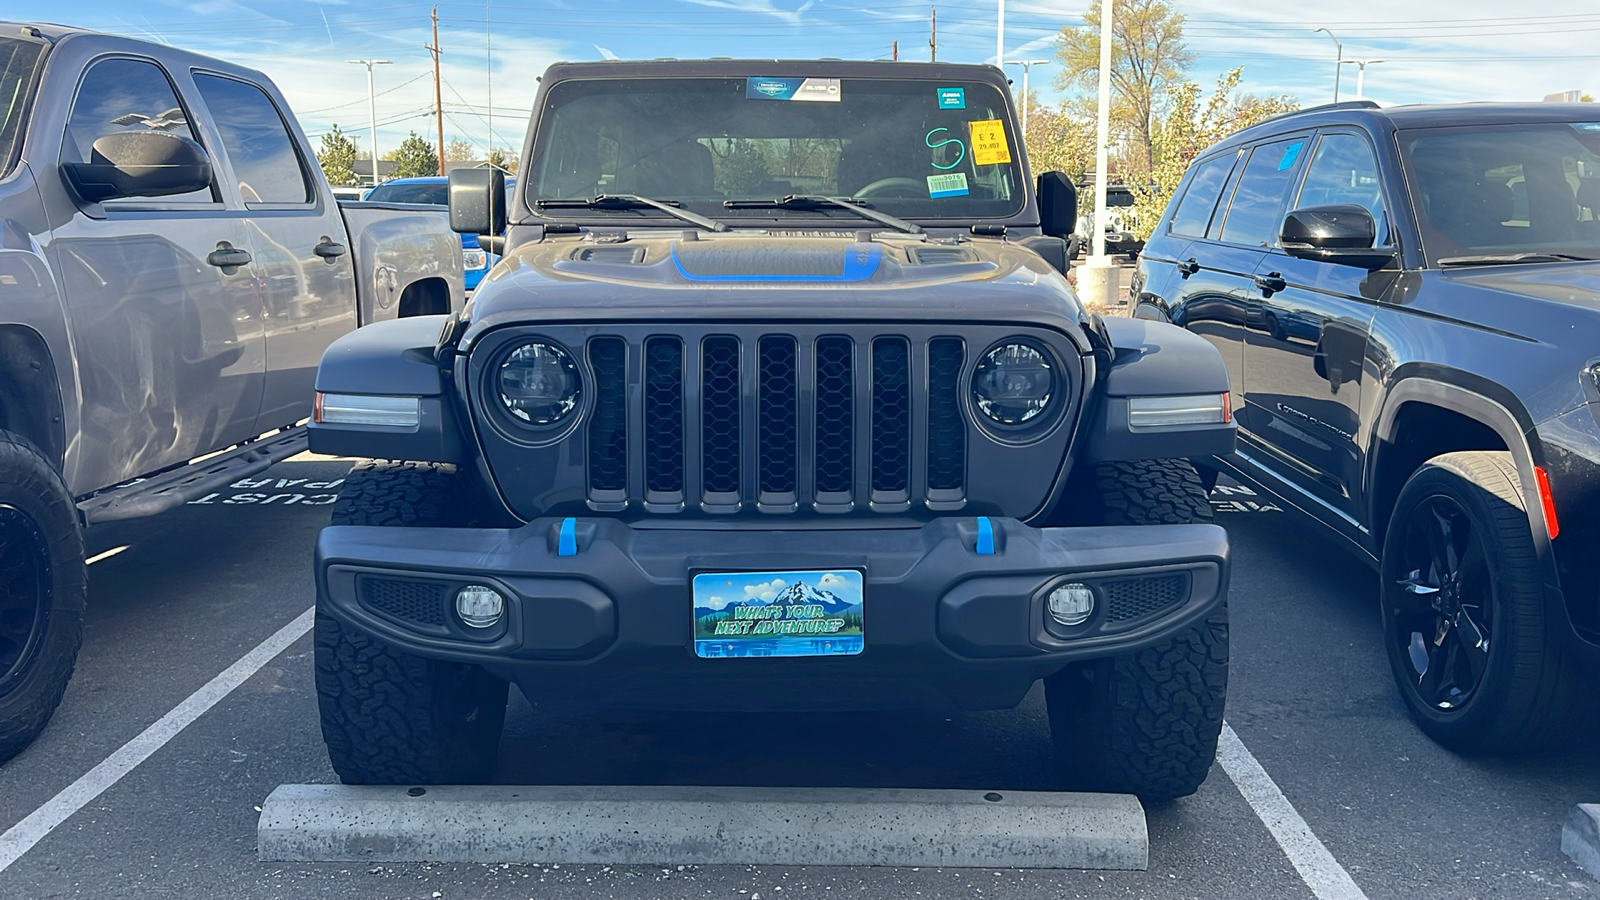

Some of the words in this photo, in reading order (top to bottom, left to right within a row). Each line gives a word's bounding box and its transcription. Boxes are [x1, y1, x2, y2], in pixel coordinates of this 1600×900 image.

[979, 133, 985, 141] E
[989, 132, 996, 140] 2
[734, 605, 783, 620] WHAT'S
[785, 604, 824, 619] YOUR
[714, 621, 753, 636] NEXT
[753, 618, 845, 635] ADVENTURE?
